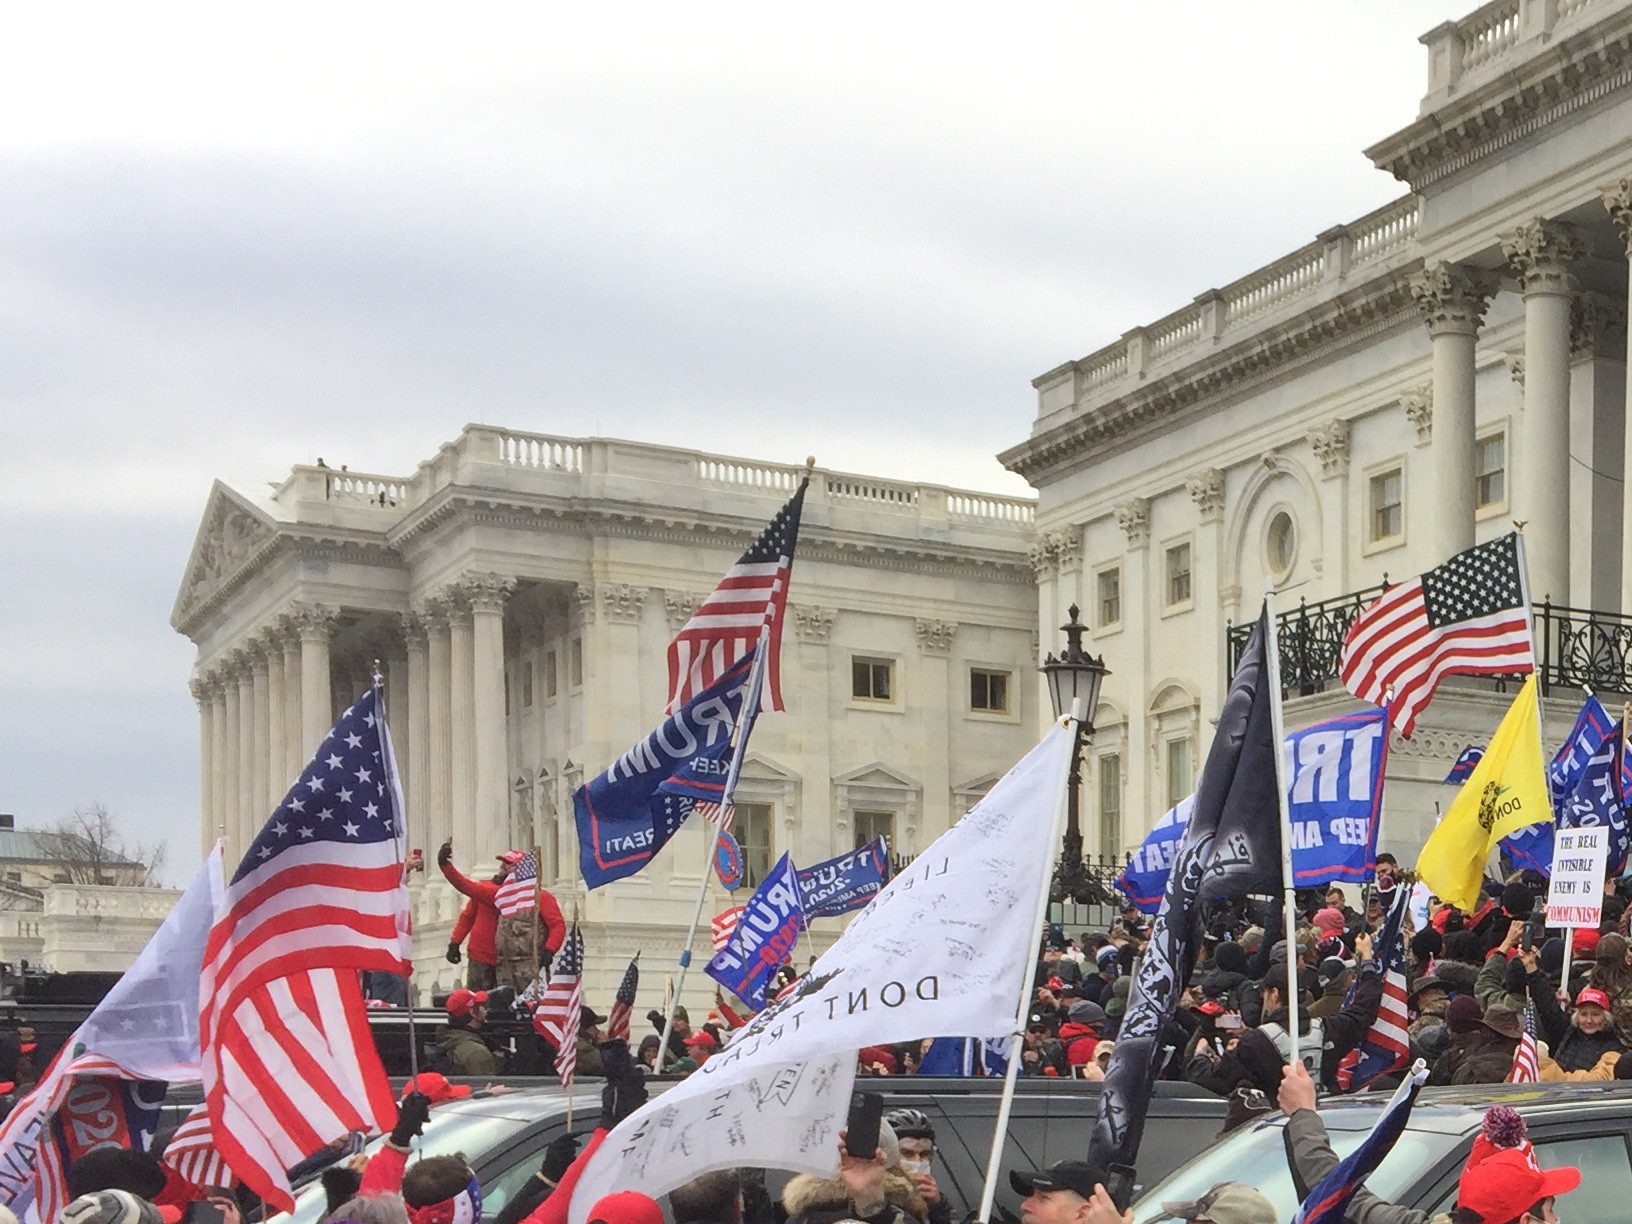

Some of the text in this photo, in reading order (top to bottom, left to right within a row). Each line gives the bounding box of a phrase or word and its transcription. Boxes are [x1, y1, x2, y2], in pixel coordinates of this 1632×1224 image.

[1560, 834, 1598, 849] THE REAL
[1557, 858, 1594, 873] INVISIBLE
[1553, 880, 1591, 894] ENEMY IS
[1545, 905, 1601, 924] COMMUNISM
